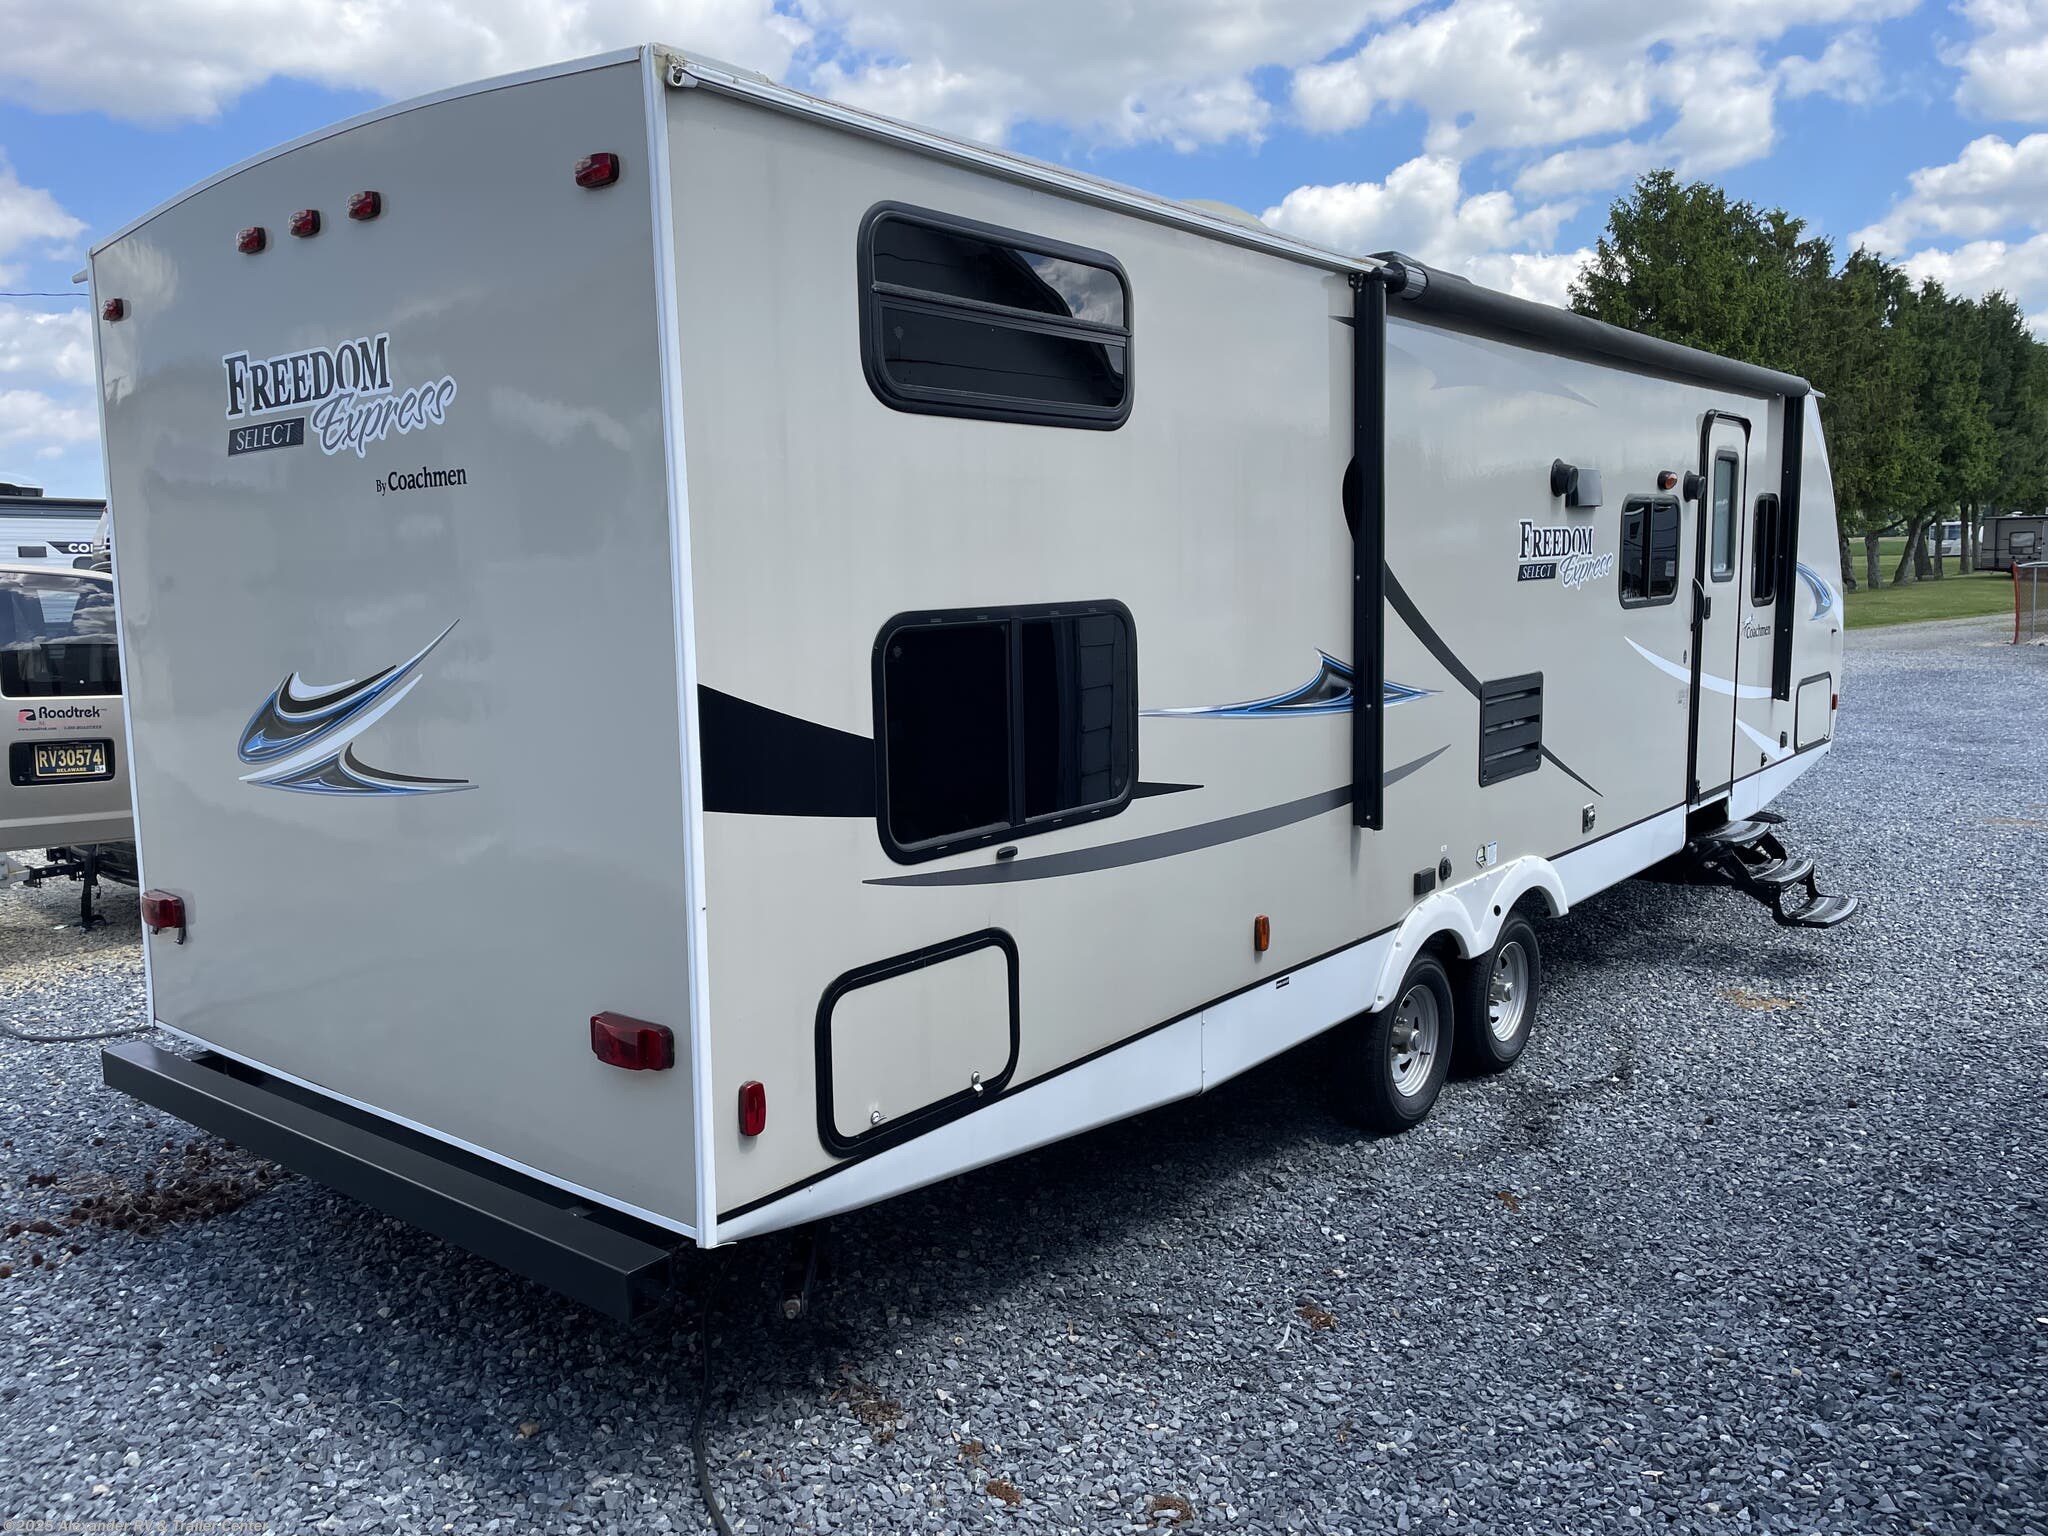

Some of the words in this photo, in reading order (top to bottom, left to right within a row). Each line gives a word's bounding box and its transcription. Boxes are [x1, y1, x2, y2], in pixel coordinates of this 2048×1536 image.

[224, 334, 391, 417] FREEDOM
[312, 377, 456, 456] Express
[236, 422, 295, 451] SELECT
[376, 479, 387, 495] By
[388, 467, 467, 491] Coachmen
[1519, 520, 1593, 558] FREEDOM
[1522, 565, 1552, 579] SELECT
[1560, 553, 1613, 589] Express
[39, 706, 101, 719] Roadtrek
[38, 749, 102, 768] RV30574
